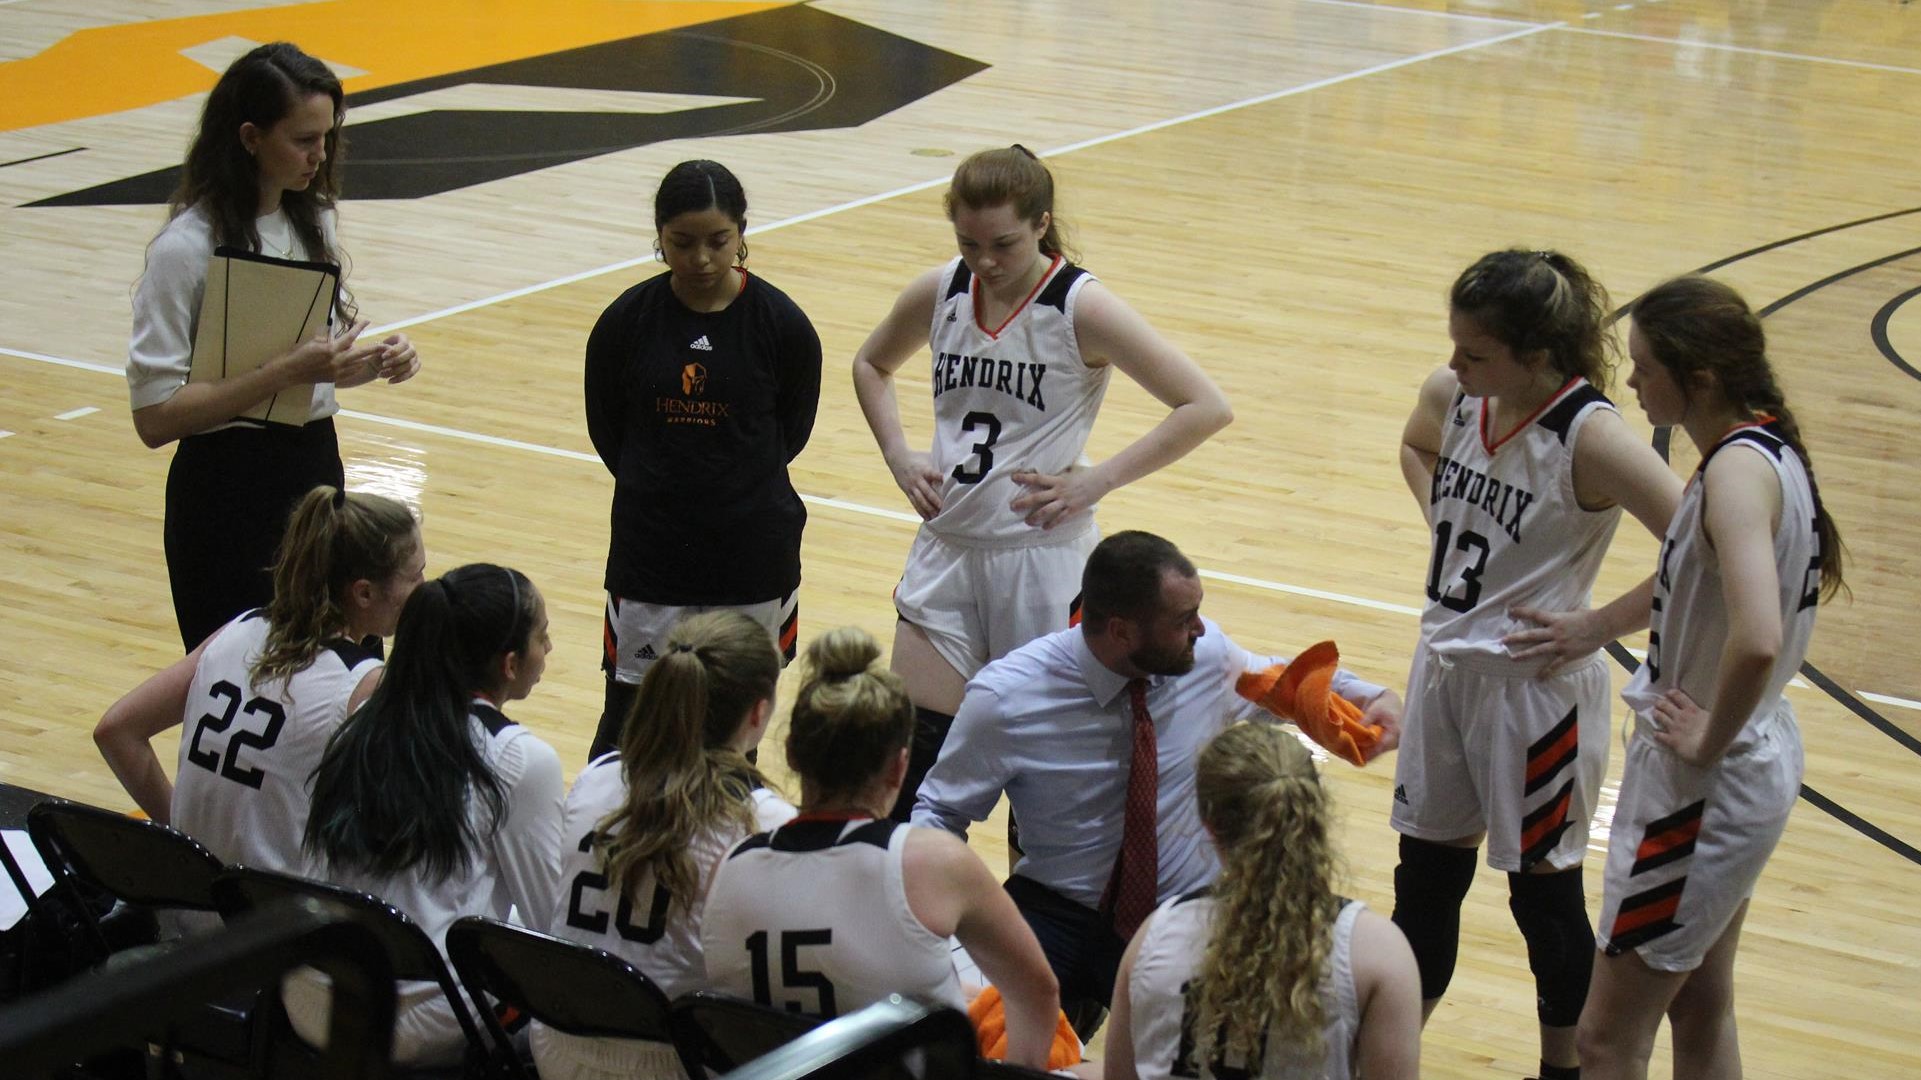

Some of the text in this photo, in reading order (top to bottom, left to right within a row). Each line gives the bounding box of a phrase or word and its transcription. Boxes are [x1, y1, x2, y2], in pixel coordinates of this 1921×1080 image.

[656, 397, 729, 417] HENDRIX
[934, 352, 1046, 412] HENDRIX
[952, 411, 1002, 484] 3
[1431, 456, 1534, 544] HENDRIX
[1427, 520, 1490, 613] 13
[188, 679, 286, 791] 22
[566, 831, 671, 945] 20
[745, 928, 838, 1019] 15
